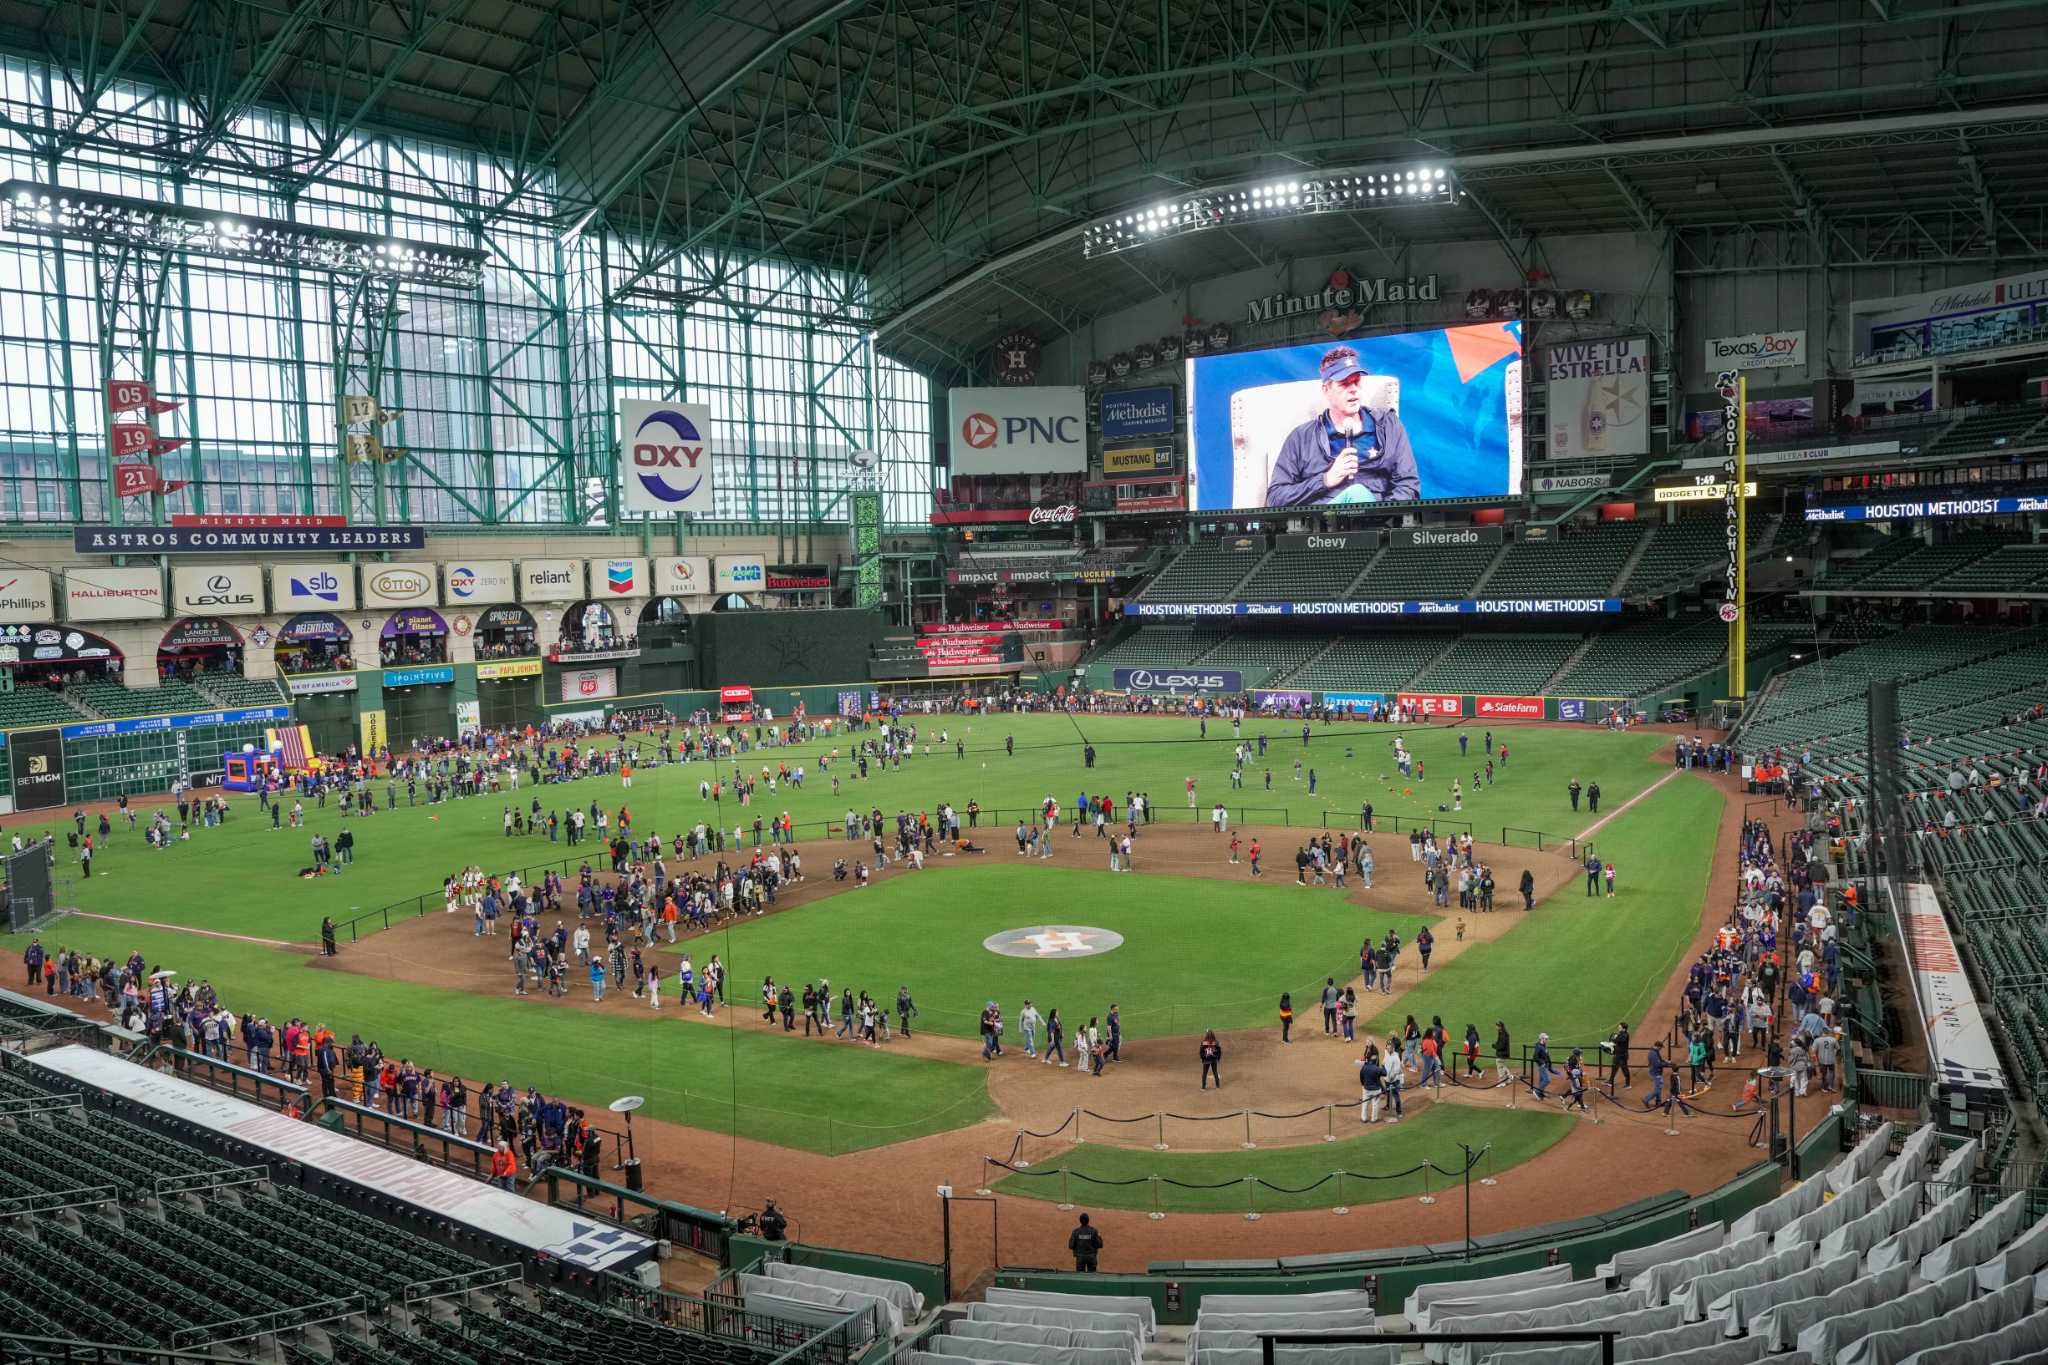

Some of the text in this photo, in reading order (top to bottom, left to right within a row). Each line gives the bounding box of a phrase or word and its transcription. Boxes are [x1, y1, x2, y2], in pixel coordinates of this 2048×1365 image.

[1248, 275, 1439, 326] Minute Maid
[1601, 341, 1629, 357] TU
[1712, 336, 1798, 357] Texas Bay
[1550, 356, 1648, 380] ESTRELLA!
[118, 387, 142, 403] 05
[352, 402, 369, 416] 17
[1107, 402, 1168, 422] Methodist
[1002, 416, 1080, 444] PNC
[122, 431, 145, 446] 19
[634, 444, 703, 468] OXY
[1112, 453, 1151, 467] MUSTANG
[125, 471, 147, 486] 21
[1556, 478, 1601, 488] NABORS
[1659, 490, 1704, 498] DOGGETT
[1866, 504, 1923, 519] HOUSTON
[1928, 499, 1999, 516] METHODIST
[199, 517, 324, 526] MINUTE MAID
[92, 531, 412, 546] ASTROS COMMUNITY LEADERS
[1308, 536, 1346, 553] Chevy
[1412, 530, 1479, 550] Silverado
[530, 570, 571, 585] reliant
[733, 564, 761, 581] LNG
[958, 569, 1050, 583] impact impact
[1074, 570, 1116, 578] PLUCKERS
[309, 571, 338, 592] slb
[378, 577, 422, 593] COTTON
[451, 577, 476, 587] OXY
[767, 575, 830, 588] Budweiser
[71, 588, 159, 599] HALLIBURTON
[185, 594, 254, 607] LEXUS
[1139, 604, 1182, 615] HOUSTON
[1183, 603, 1237, 614] METHODIST
[1293, 602, 1348, 614] HOUSTON
[1349, 602, 1405, 613] METHODIST
[1476, 601, 1533, 612] HOUSTON
[1535, 600, 1606, 611] METHODIST
[409, 616, 432, 624] planet
[412, 623, 437, 631] fitness
[1013, 621, 1051, 630] Budweiser
[296, 622, 335, 633] RELENTLESS
[942, 638, 985, 646] Budweiser
[938, 647, 982, 656] Budweiser
[313, 680, 340, 690] AMERICA
[582, 681, 595, 691] 66
[1154, 675, 1225, 687] LEXUS
[1336, 699, 1378, 707] HOND
[179, 733, 188, 787] AMERICAN
[17, 772, 61, 786] BETMGM
